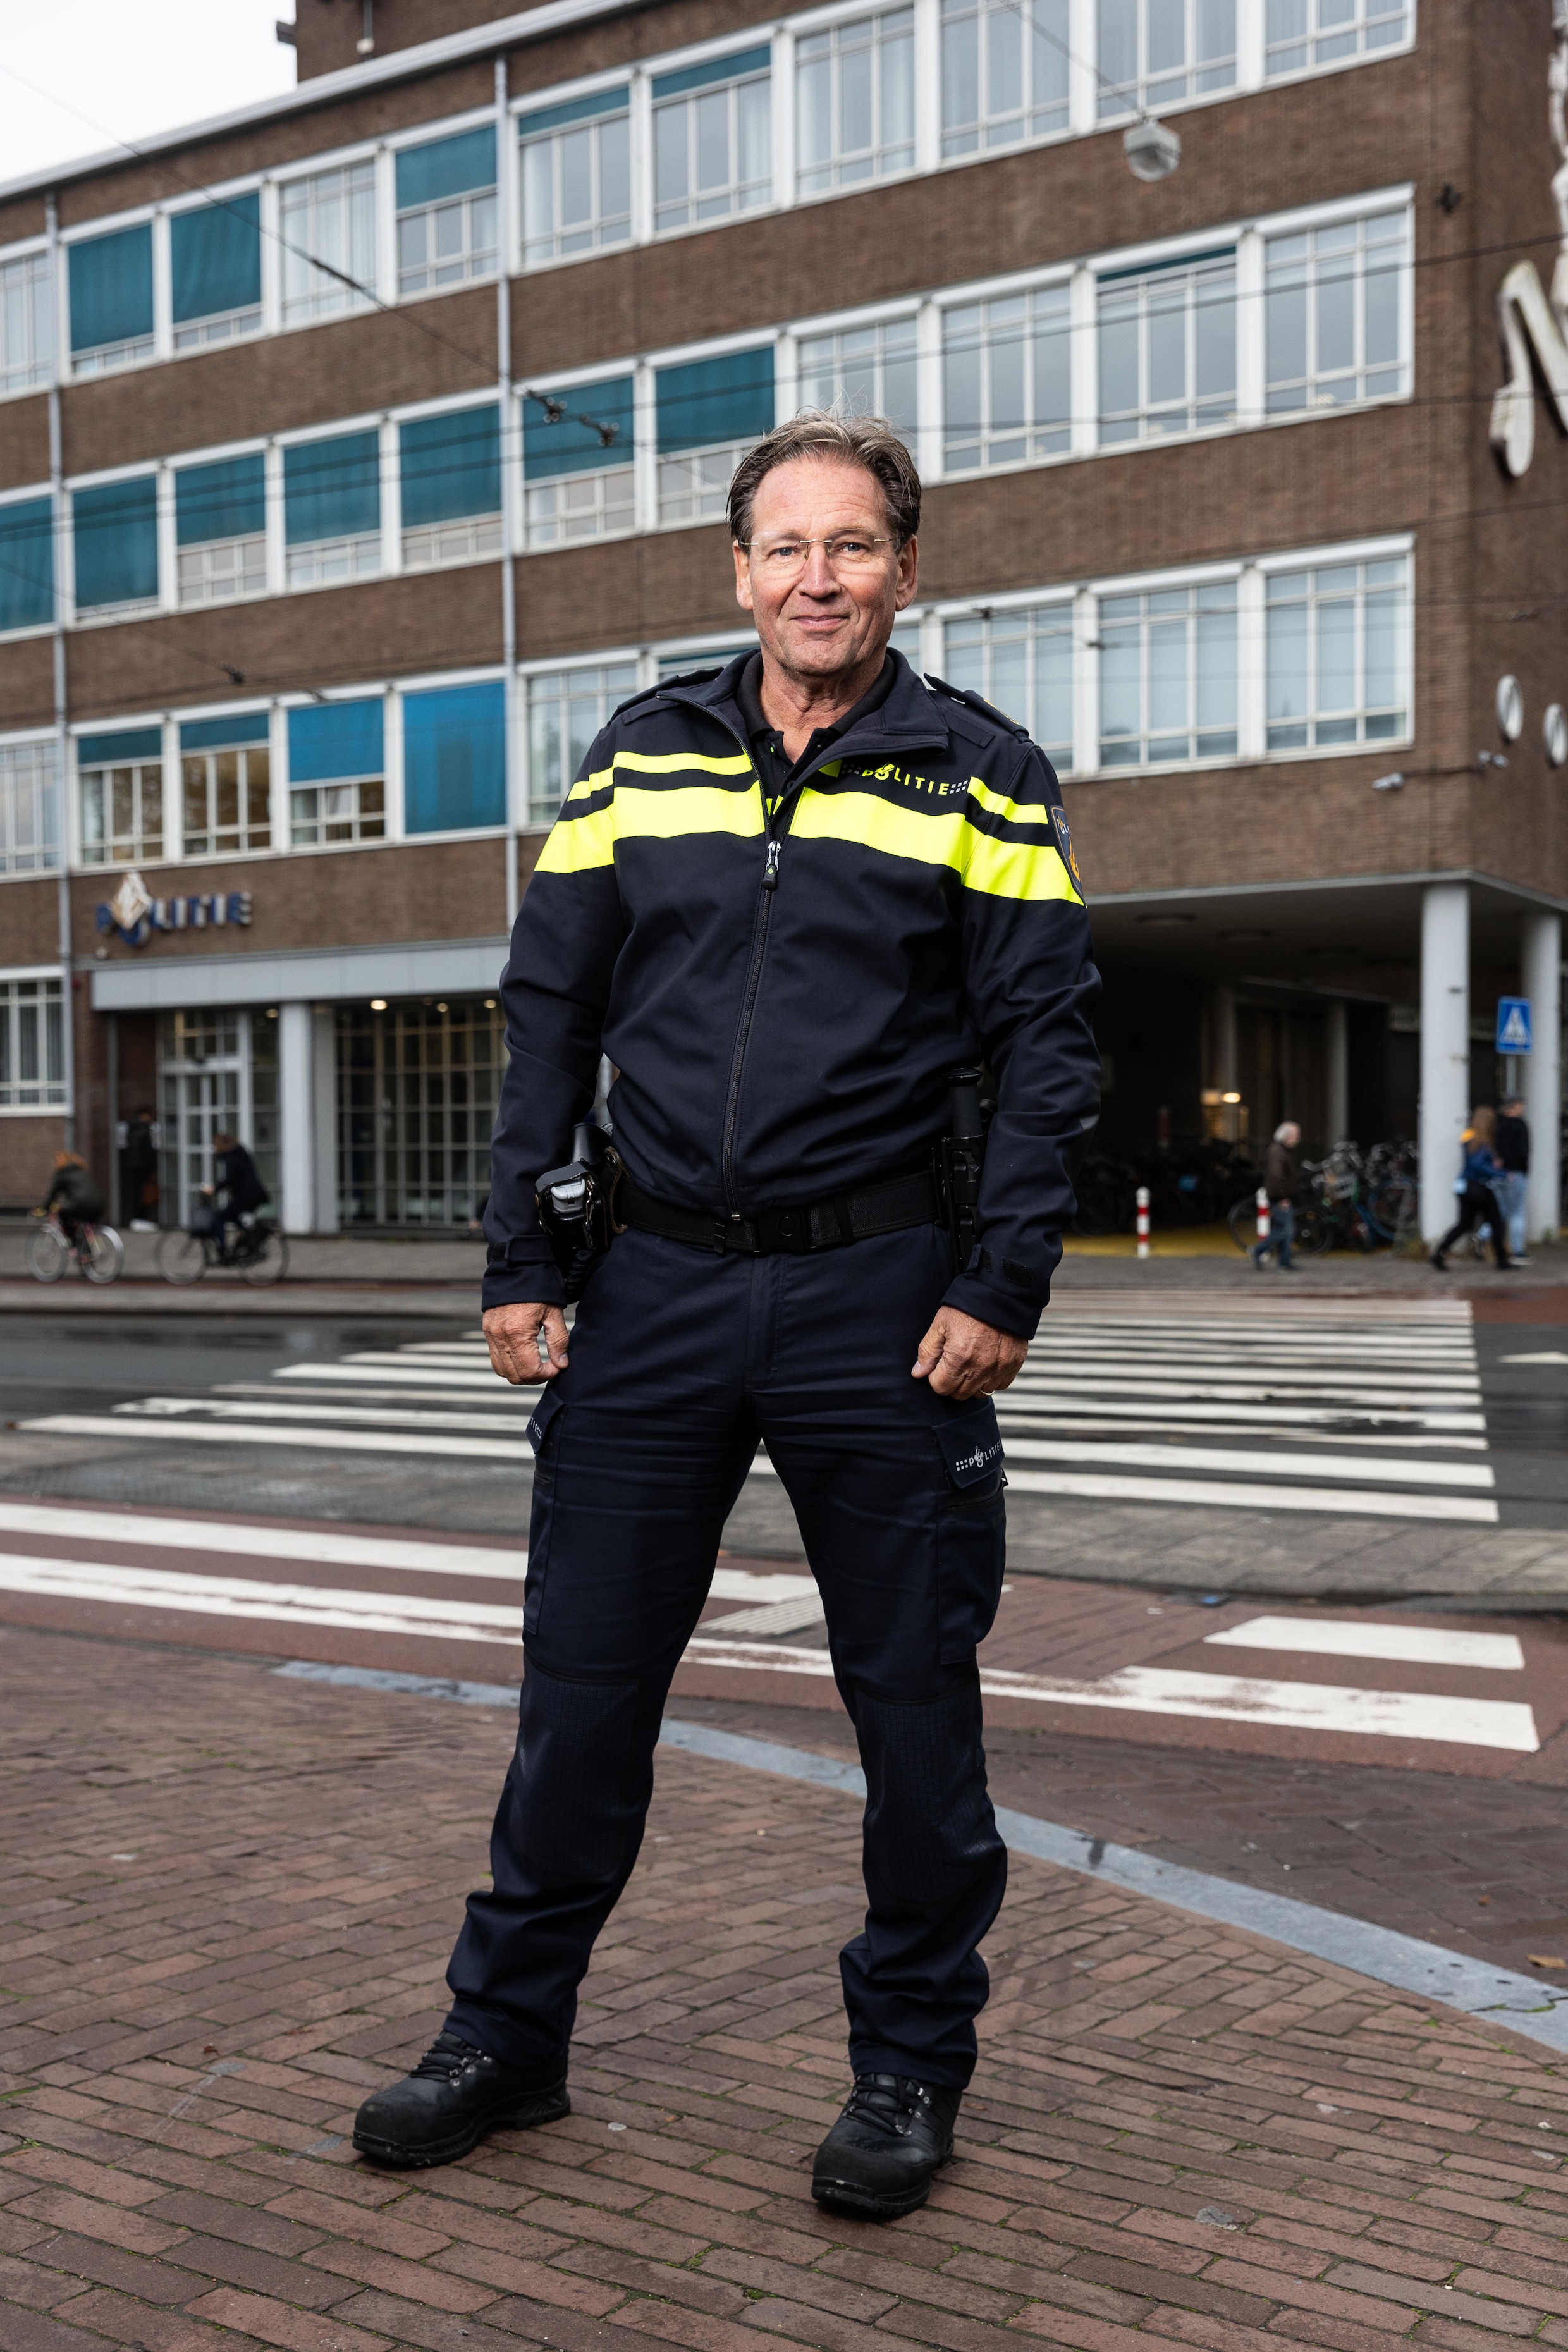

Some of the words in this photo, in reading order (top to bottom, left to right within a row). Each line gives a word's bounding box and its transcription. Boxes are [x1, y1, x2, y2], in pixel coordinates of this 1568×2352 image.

[862, 764, 950, 795] POLITIE
[96, 888, 253, 946] POLITIE
[969, 1442, 1000, 1467] POLITIE
